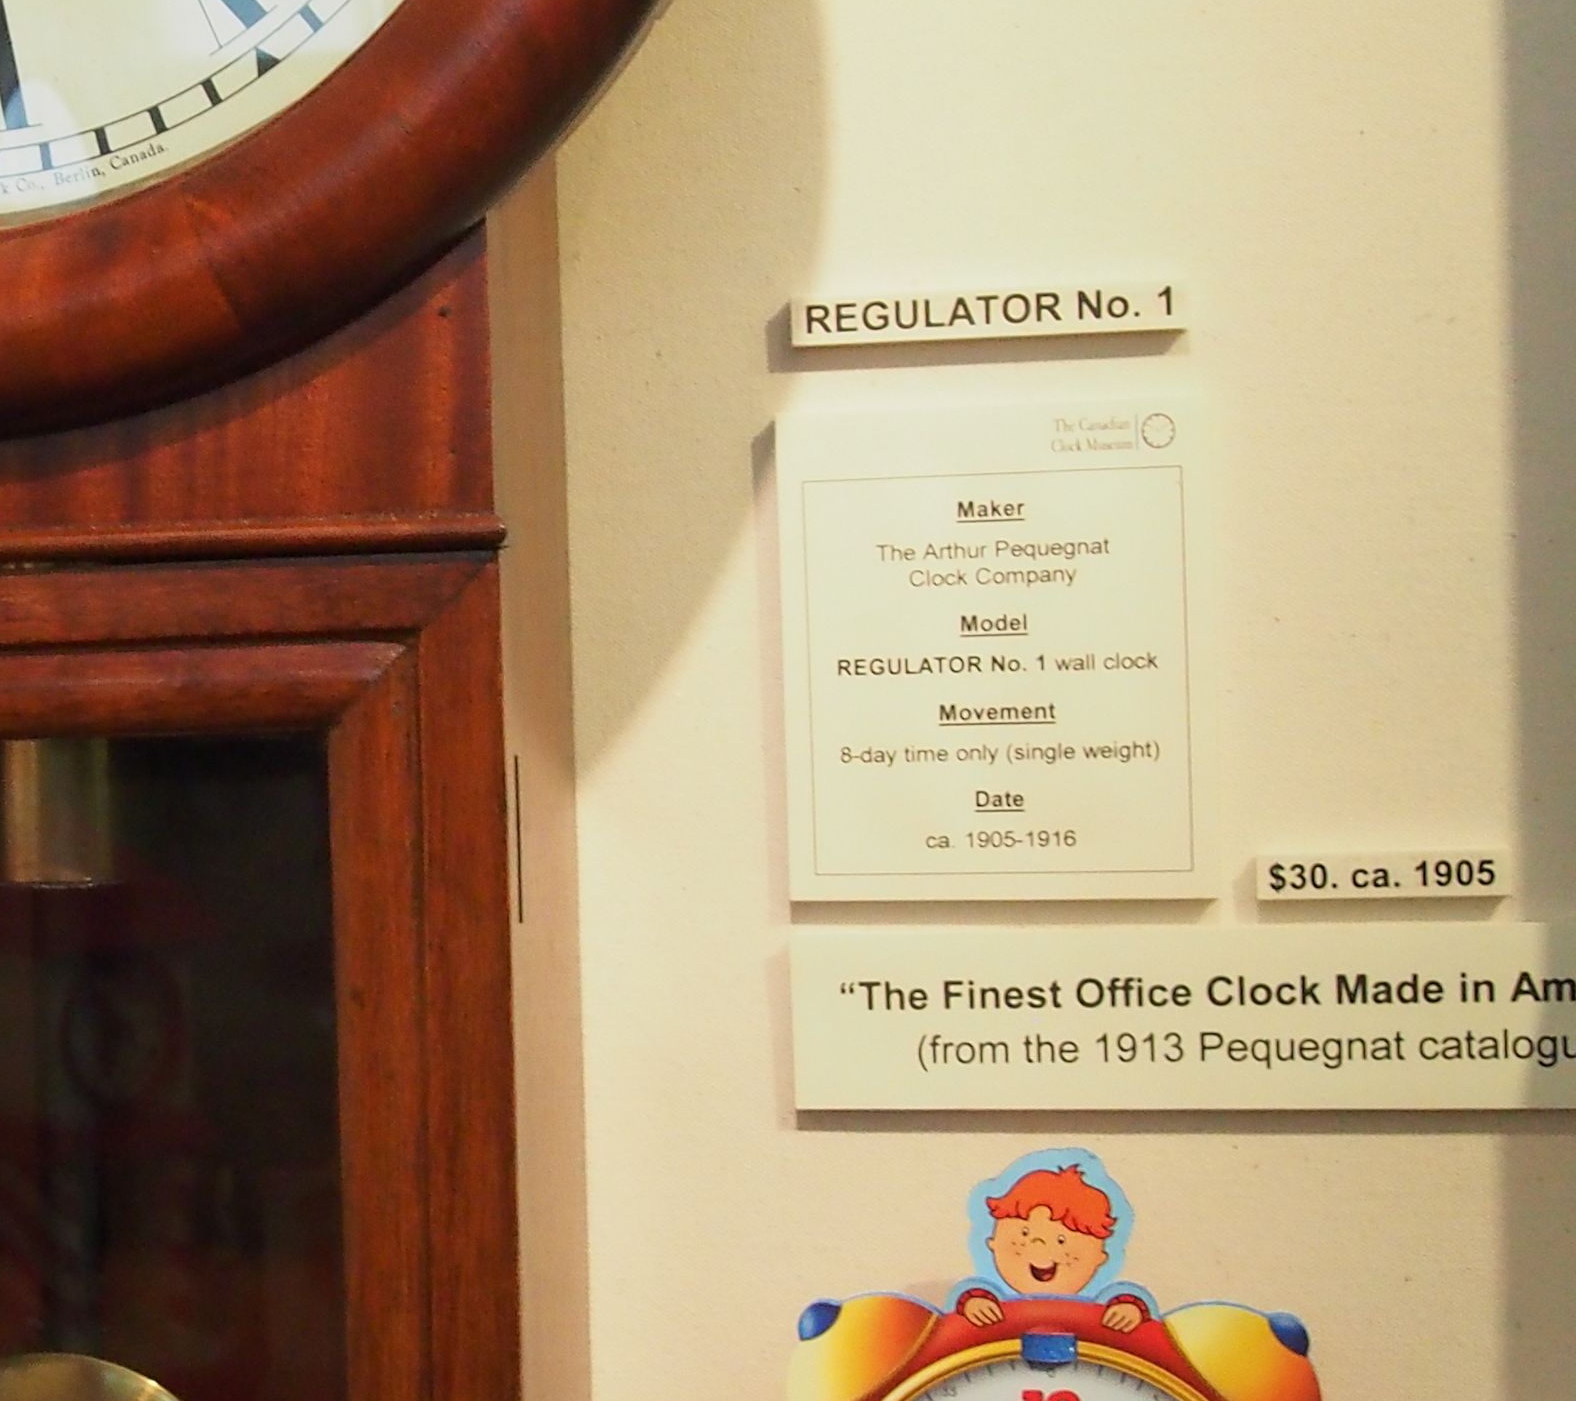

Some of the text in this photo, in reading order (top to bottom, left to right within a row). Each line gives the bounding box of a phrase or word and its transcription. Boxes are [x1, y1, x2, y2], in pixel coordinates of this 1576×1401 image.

[109, 142, 169, 170] Canada.
[806, 285, 1174, 334] REGULATOR No. 1
[957, 500, 1025, 521] Maker
[877, 538, 1110, 562] The Arthur Pequegnat
[909, 566, 1076, 587] Clock Company
[960, 614, 1028, 634] Model
[838, 652, 1159, 676] REGULATOR No. 1 wall clock
[939, 703, 1056, 723] Movement
[840, 741, 1160, 767] 8-day time only (single weight)
[975, 790, 1025, 809] Date
[967, 830, 1077, 848] 1905-1916
[1270, 860, 1495, 892] $30. ca. 1905
[840, 971, 1576, 1010] “The Finest Office Clock Made in Am
[918, 1029, 1576, 1071] (from the 1913 Pequegnat catalogu
